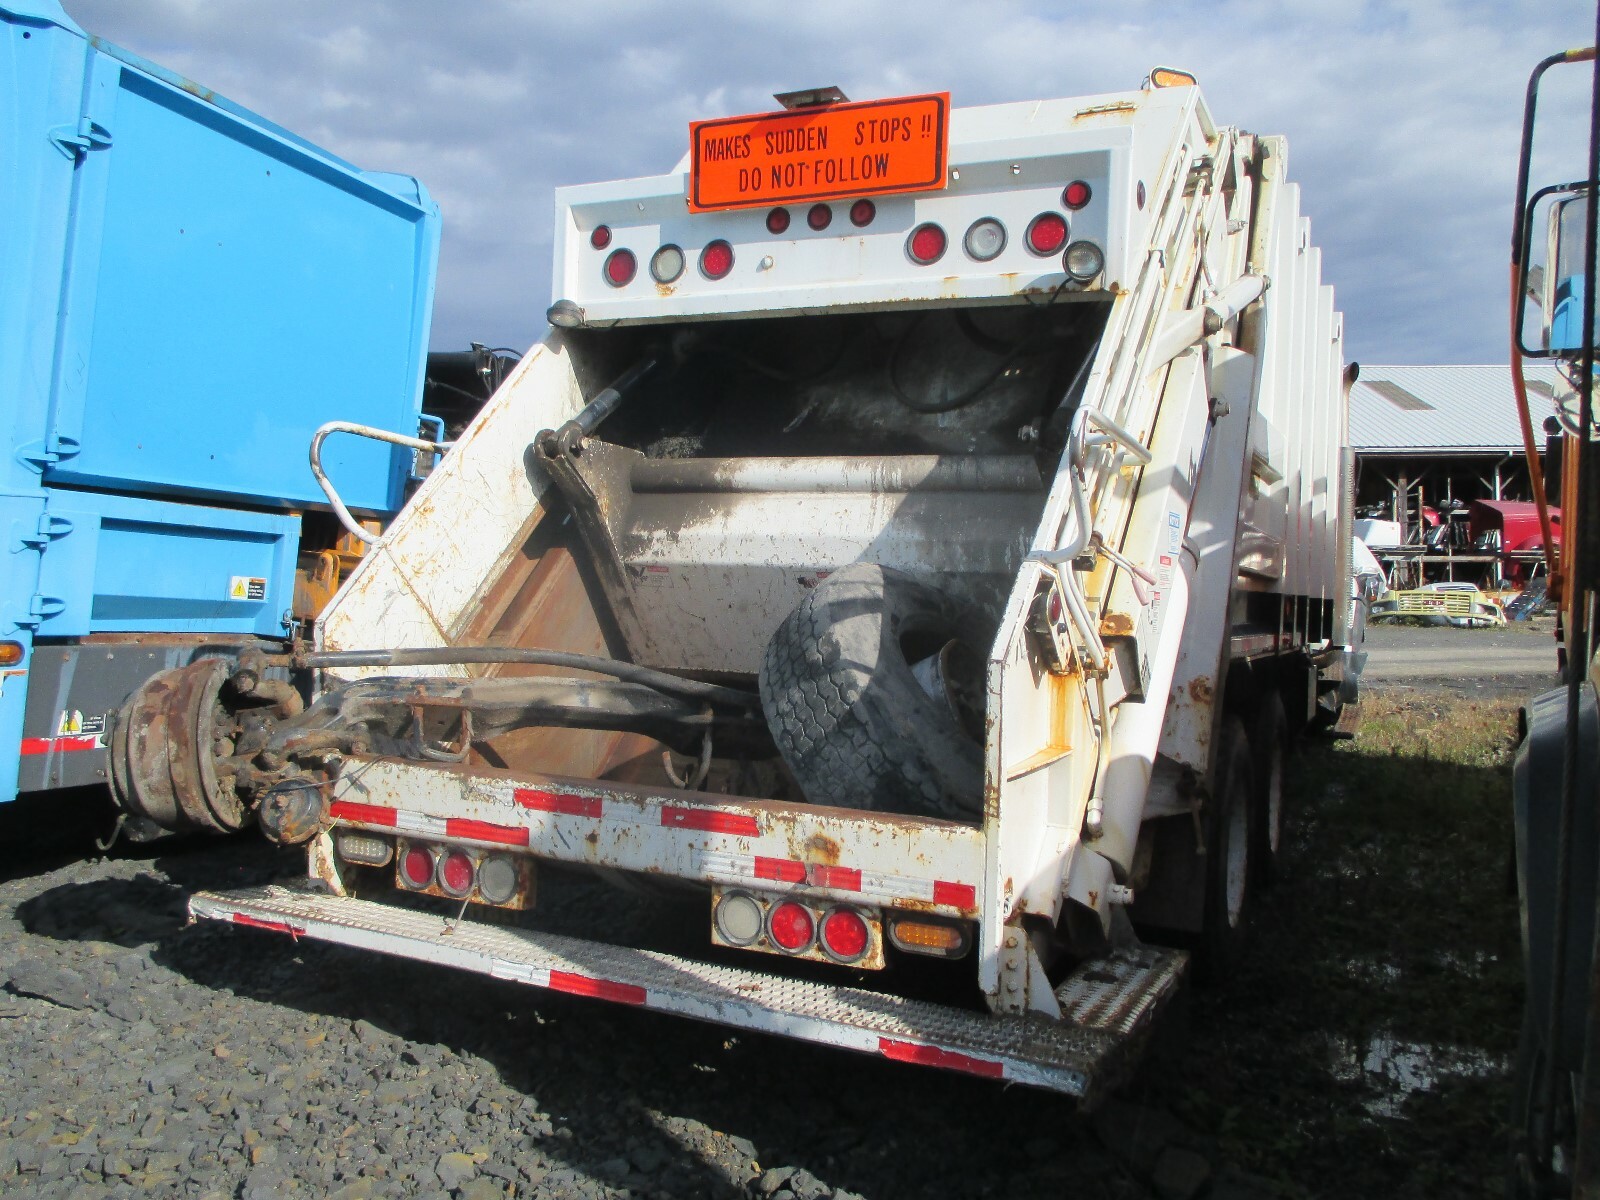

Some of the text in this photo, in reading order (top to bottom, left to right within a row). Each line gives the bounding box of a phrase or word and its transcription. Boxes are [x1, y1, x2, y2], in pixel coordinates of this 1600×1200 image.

[704, 134, 751, 162] MAKES
[765, 126, 828, 156] SUDDEN
[855, 117, 912, 146] STOPS
[739, 153, 889, 192] DO NOT FOLLOW
